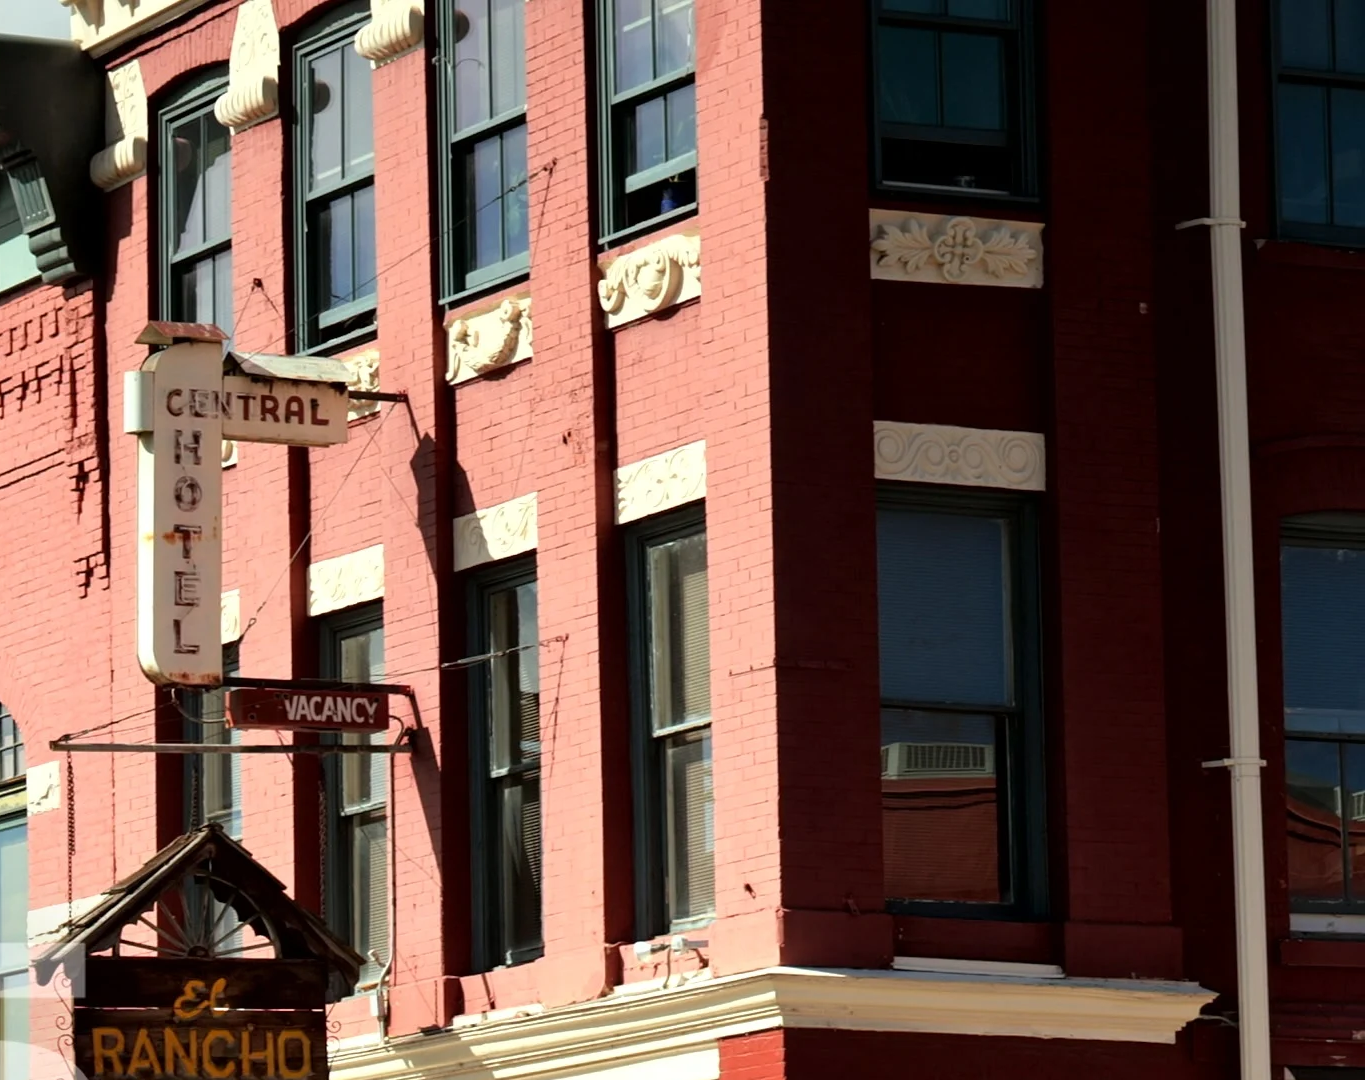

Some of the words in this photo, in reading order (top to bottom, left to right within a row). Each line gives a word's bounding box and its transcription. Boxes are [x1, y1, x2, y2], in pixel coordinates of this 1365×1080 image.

[166, 387, 330, 426] CENTRAL
[173, 429, 203, 656] HOTEL
[284, 696, 379, 724] VACANCY
[173, 977, 231, 1021] El
[92, 1027, 312, 1080] RANCHO
